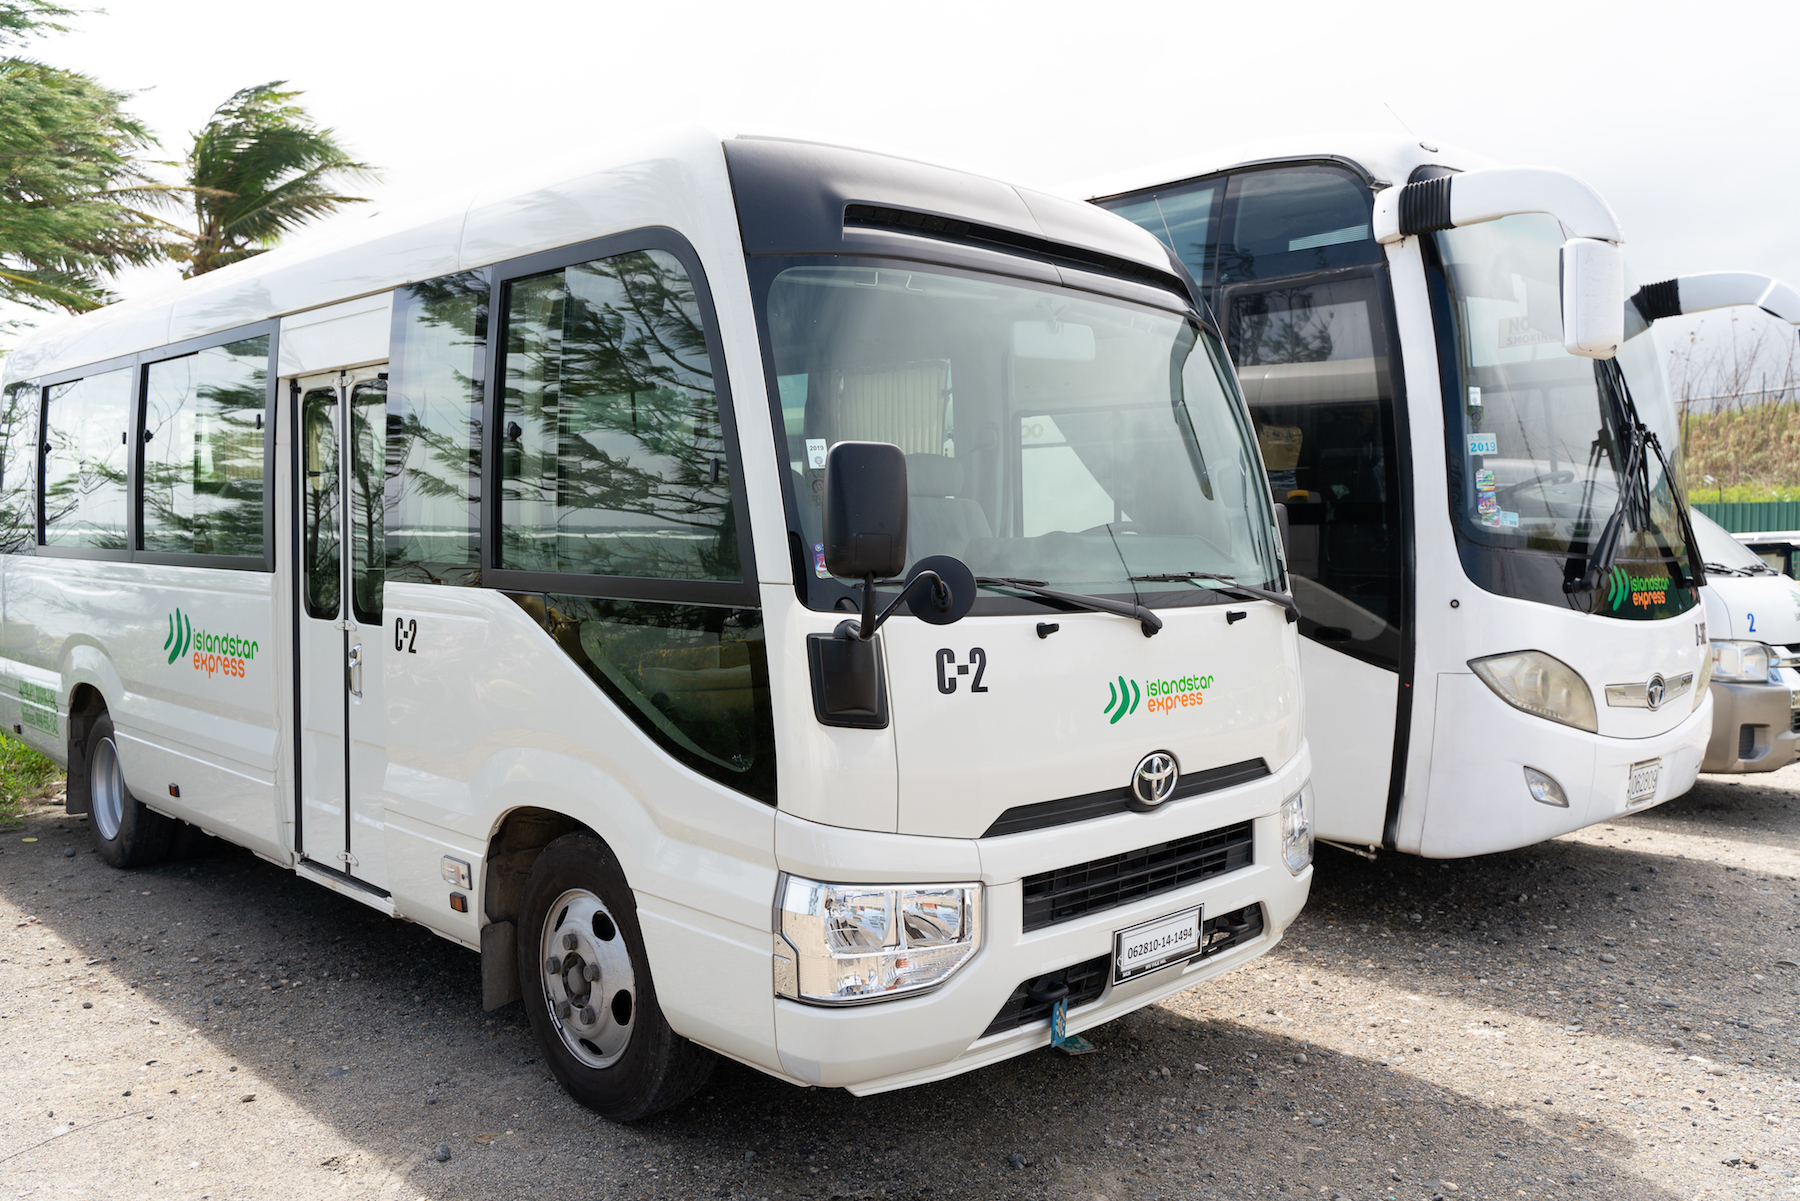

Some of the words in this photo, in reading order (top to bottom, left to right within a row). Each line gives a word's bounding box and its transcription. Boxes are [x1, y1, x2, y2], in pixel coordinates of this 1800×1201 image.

[1470, 442, 1496, 452] 2019
[1629, 575, 1670, 592] islandstar
[1632, 590, 1666, 610] express
[1747, 613, 1757, 632] 2
[193, 628, 259, 661] islandstar
[394, 617, 417, 654] C-2
[193, 652, 246, 680] express
[935, 647, 989, 695] C-2
[1146, 674, 1214, 697] islandstar
[1147, 692, 1204, 716] express
[1631, 769, 1658, 795] 062809
[1127, 926, 1193, 960] 062810-14-1494
